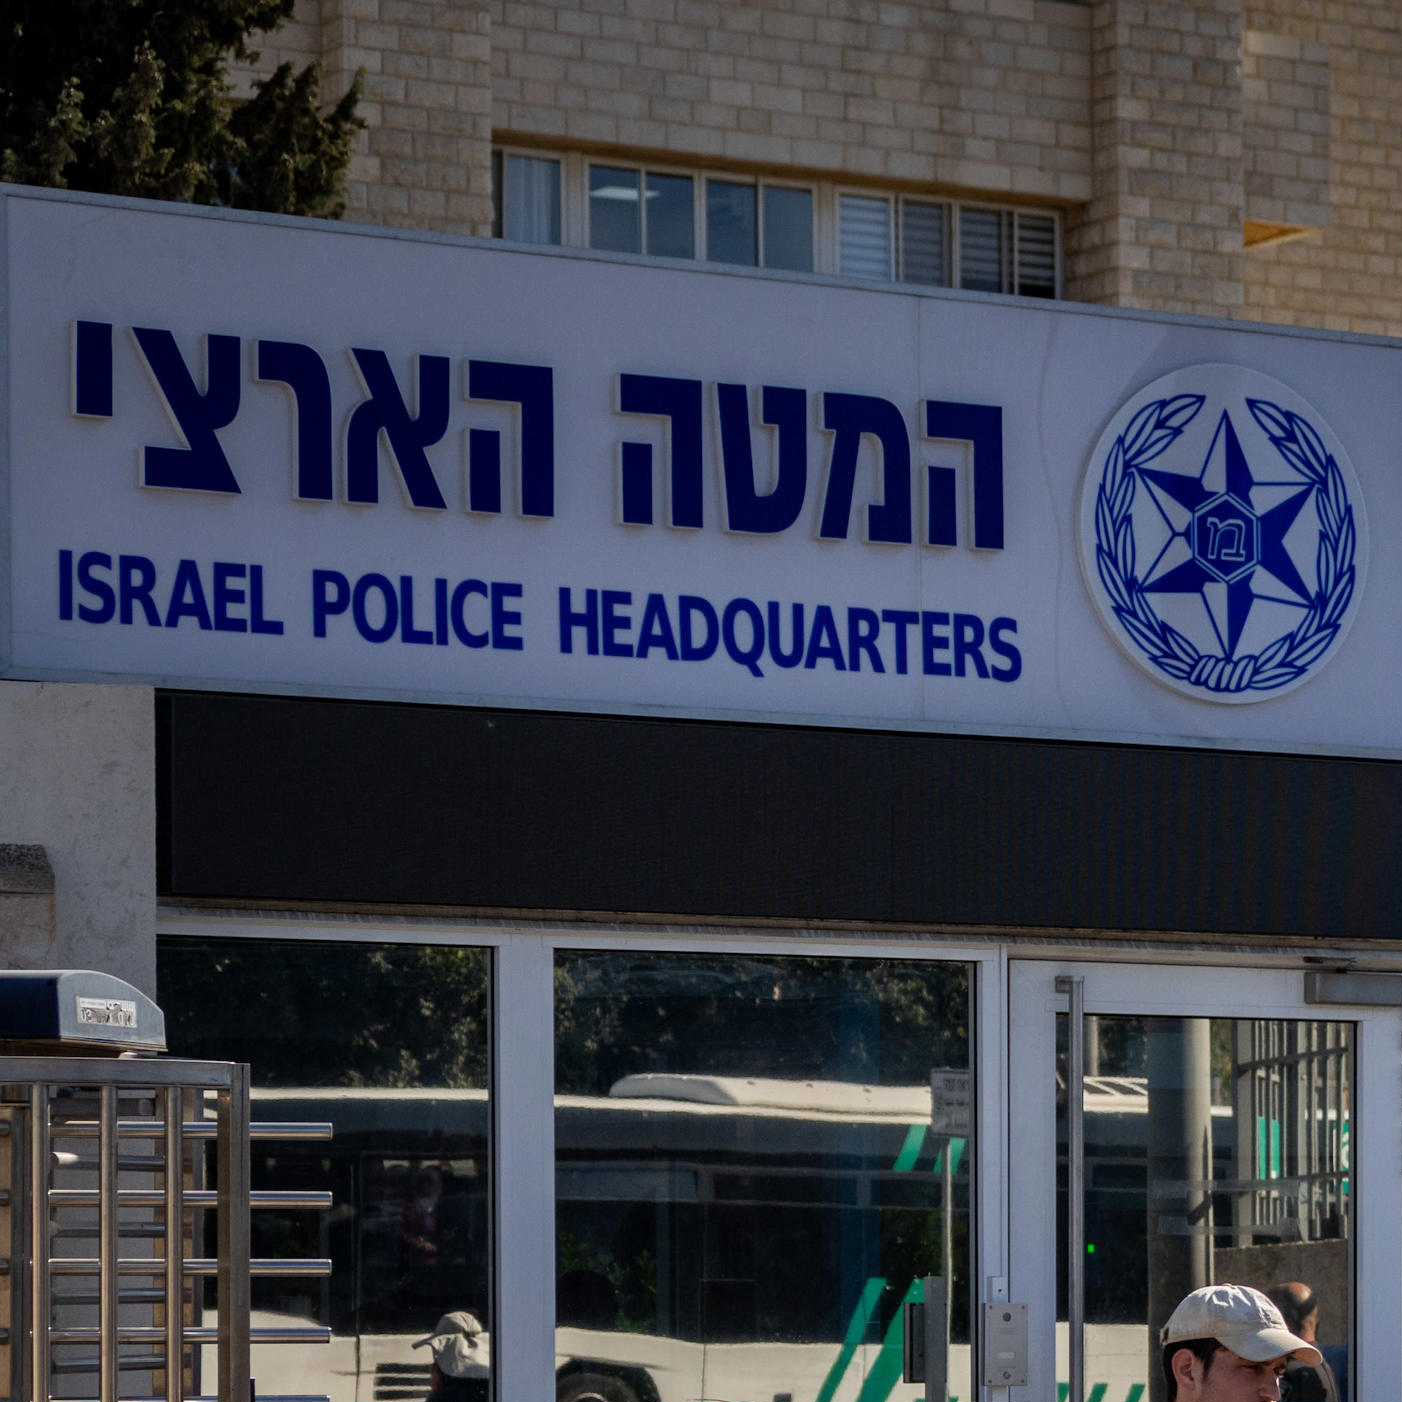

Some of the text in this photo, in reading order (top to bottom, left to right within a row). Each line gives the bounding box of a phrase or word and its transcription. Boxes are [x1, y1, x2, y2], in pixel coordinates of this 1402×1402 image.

[72, 319, 1004, 550] המטה הארצי
[57, 549, 1023, 683] ISRAEL POLICE HEADQUARTERS
